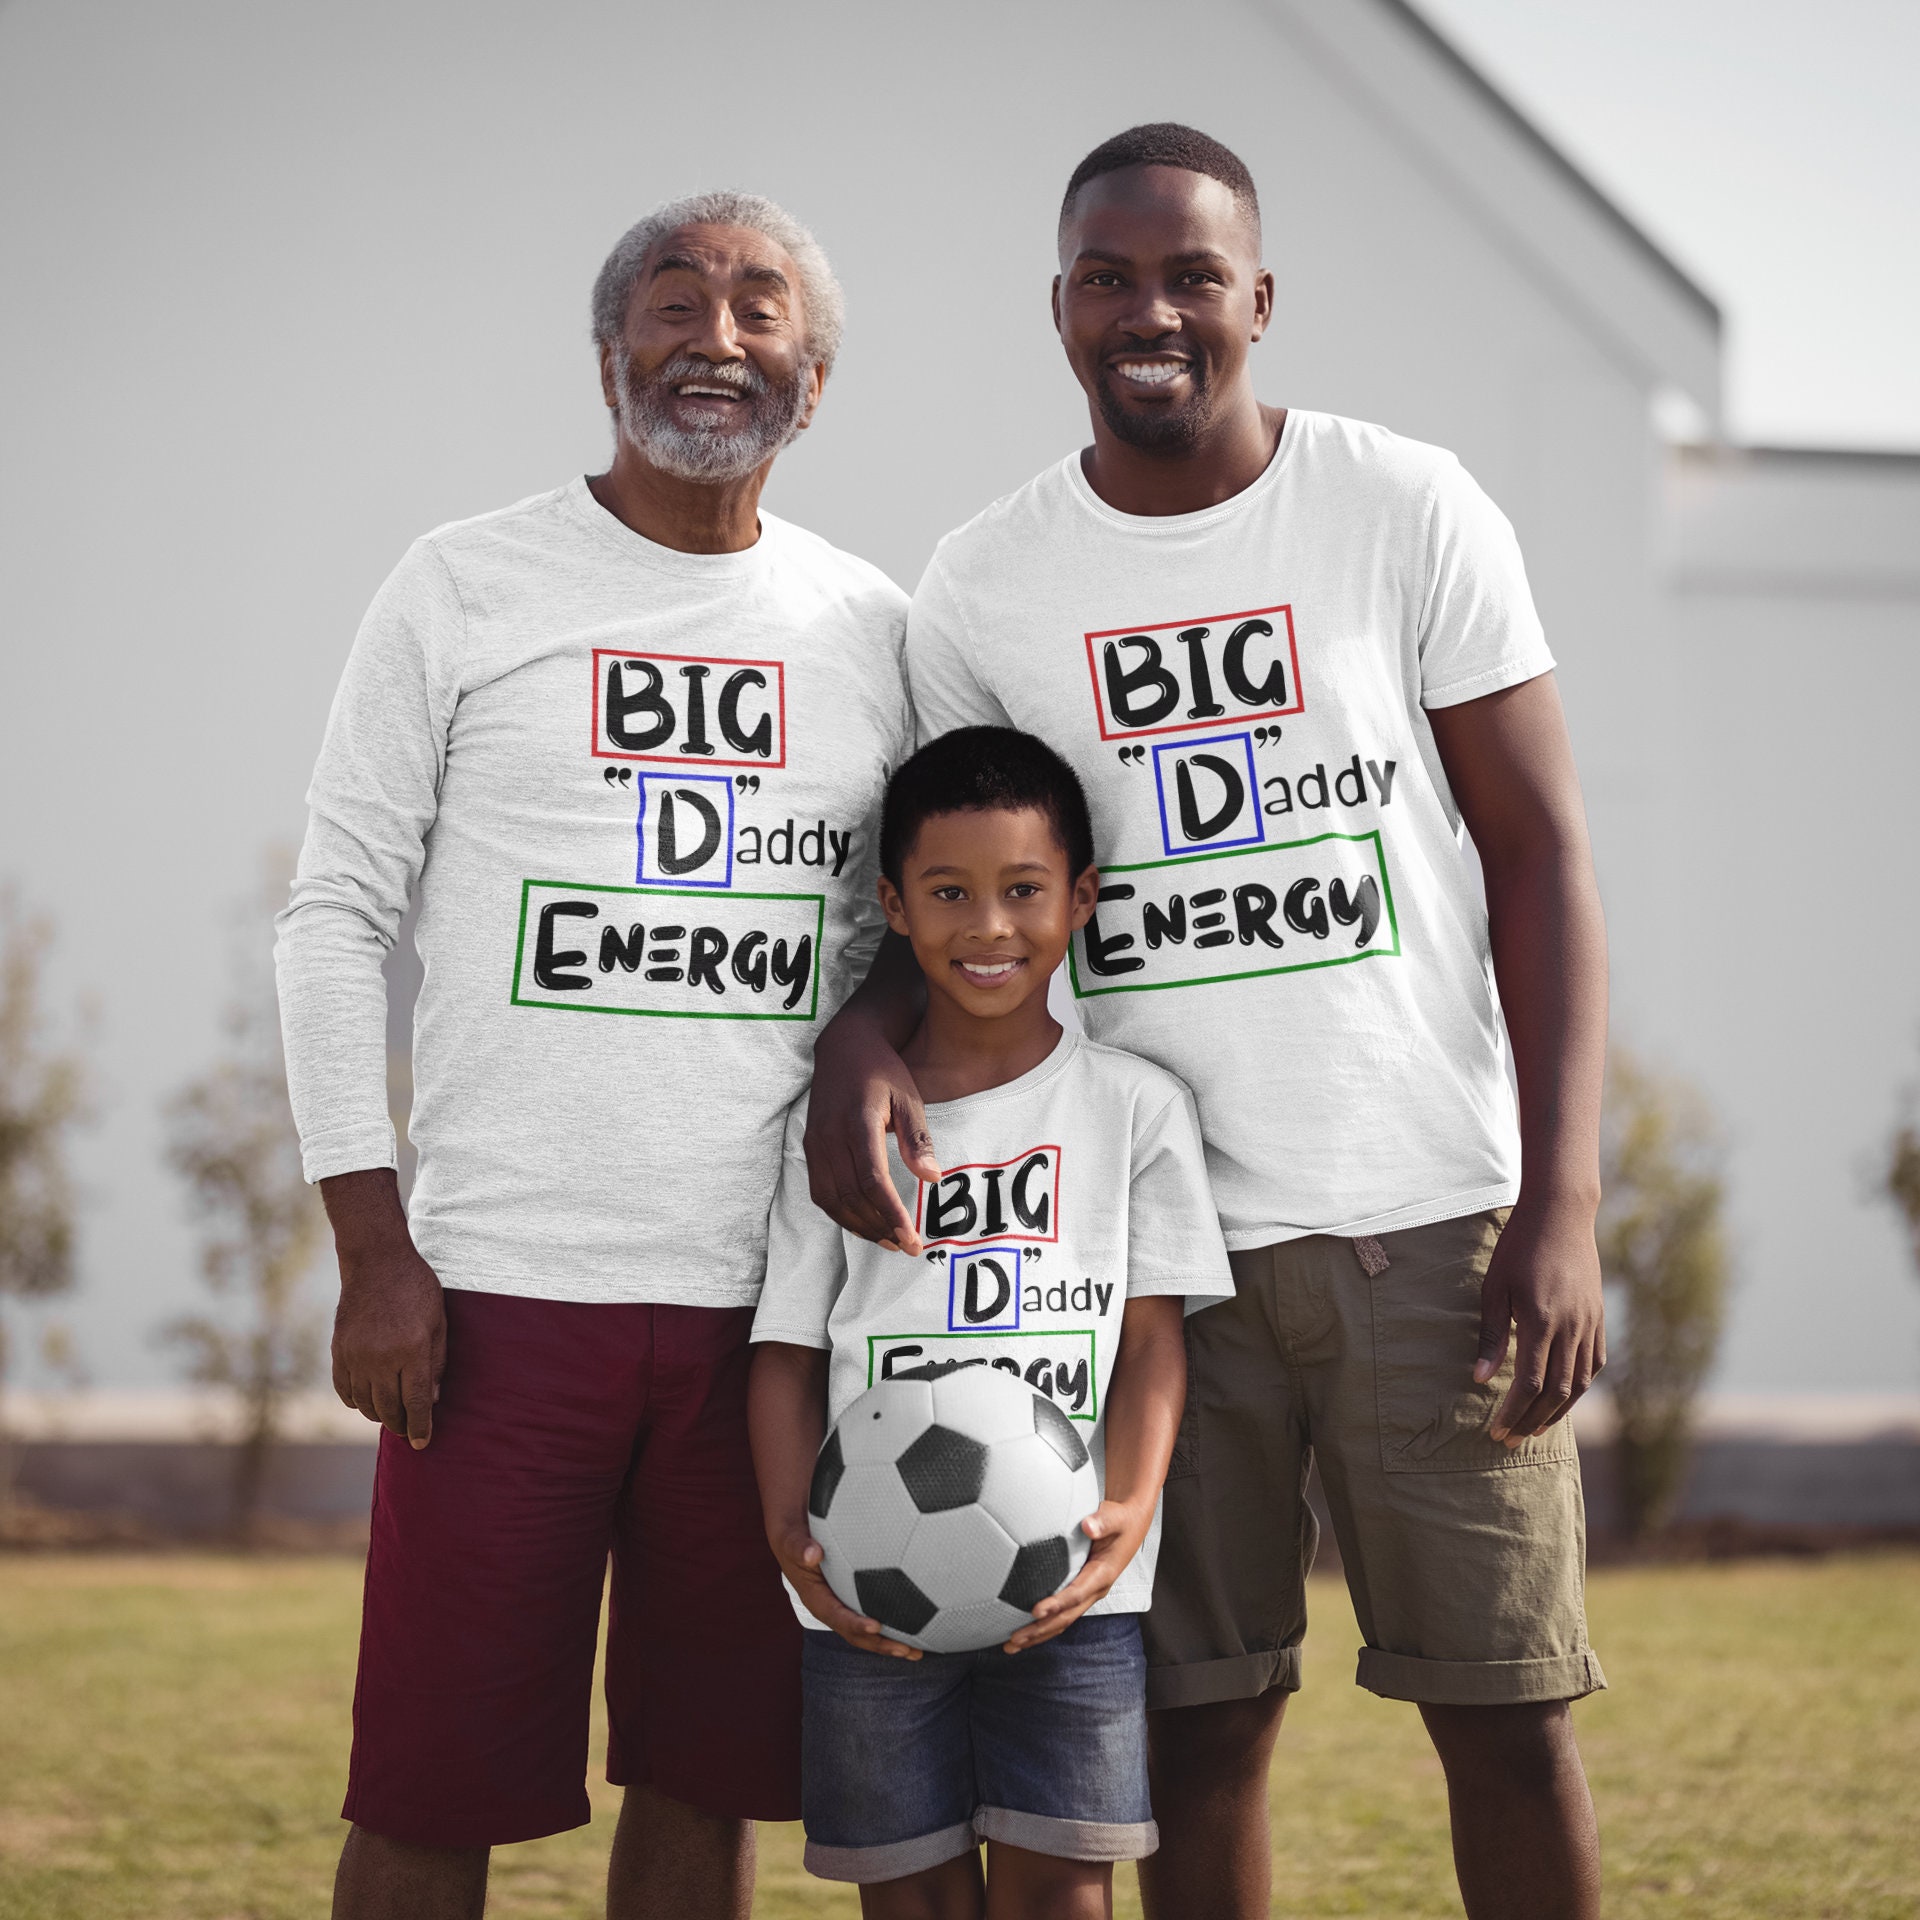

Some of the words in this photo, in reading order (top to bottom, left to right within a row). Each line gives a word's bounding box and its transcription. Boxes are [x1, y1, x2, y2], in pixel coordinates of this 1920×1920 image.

[606, 660, 772, 758] BIG
[1103, 619, 1287, 728] BIG
[926, 1153, 1050, 1240] BIG
